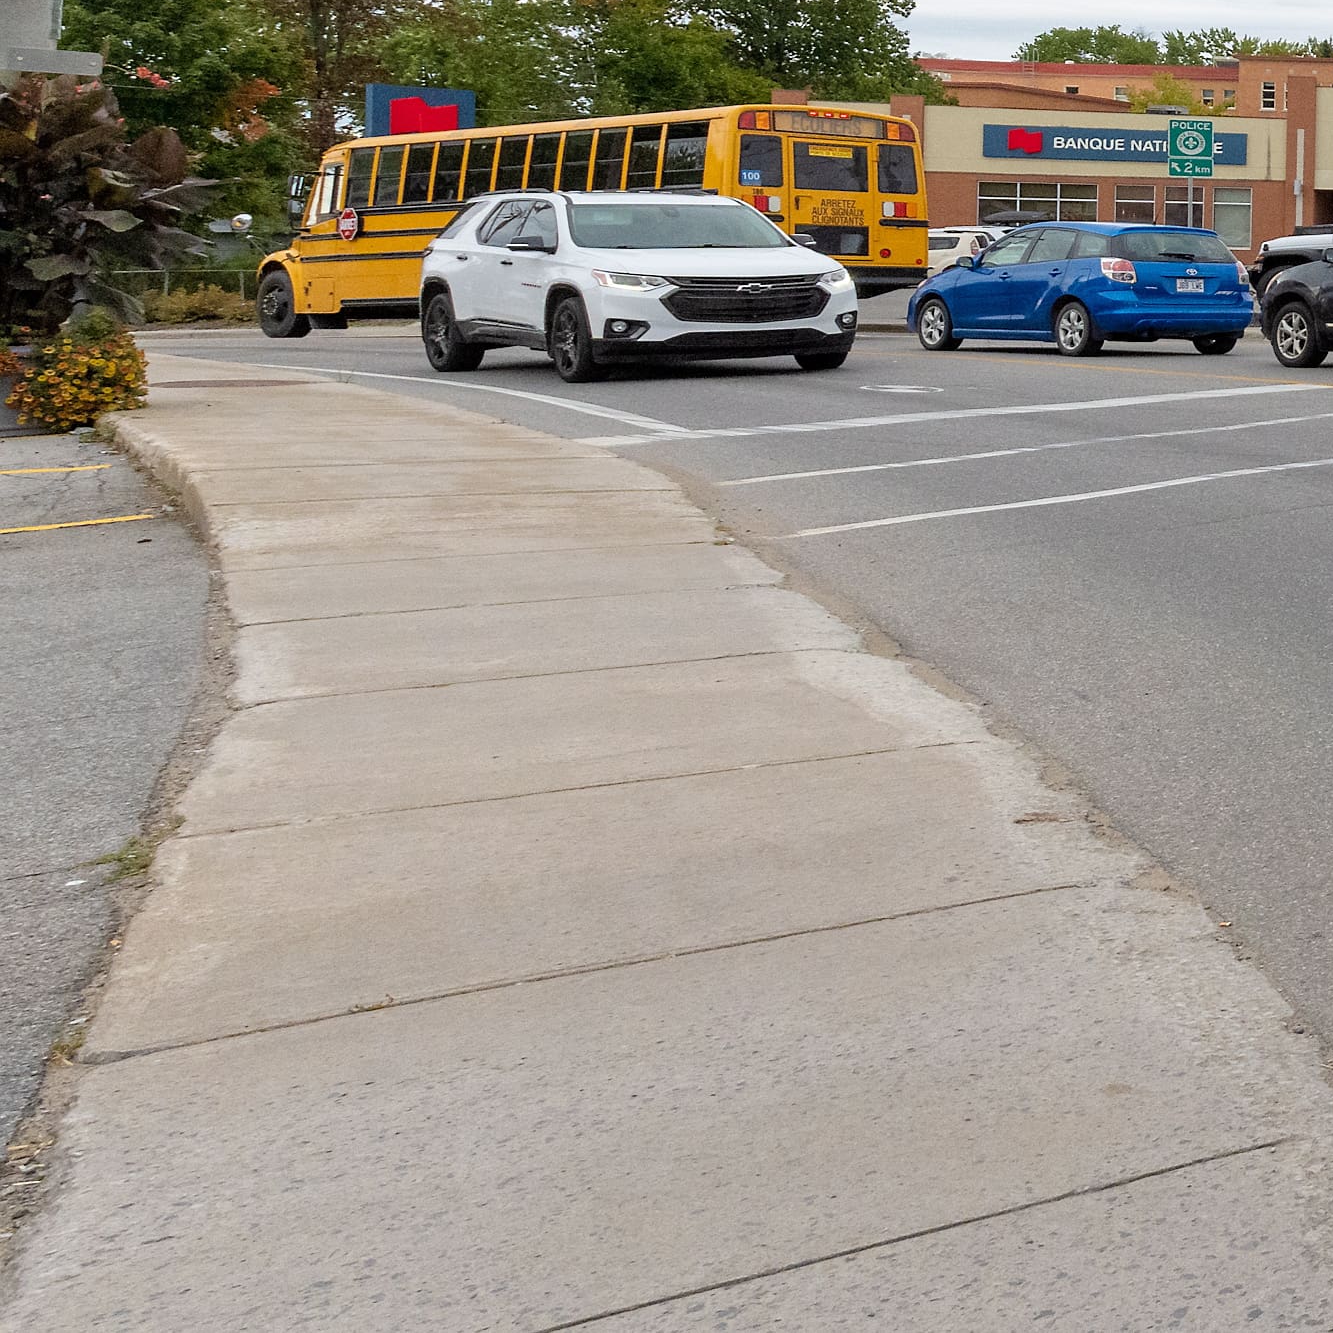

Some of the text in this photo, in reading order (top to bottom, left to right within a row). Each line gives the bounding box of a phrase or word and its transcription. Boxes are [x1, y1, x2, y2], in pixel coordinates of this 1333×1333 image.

[1171, 121, 1211, 131] POLICE
[1053, 136, 1125, 152] BANQUE
[1130, 139, 1223, 155] NATIE
[1184, 162, 1211, 173] 2 km
[742, 171, 760, 180] 100
[820, 198, 856, 209] ARRETEZ
[811, 206, 864, 217] AUX SIGNAUX
[811, 215, 865, 226] CLIGNOTANTS
